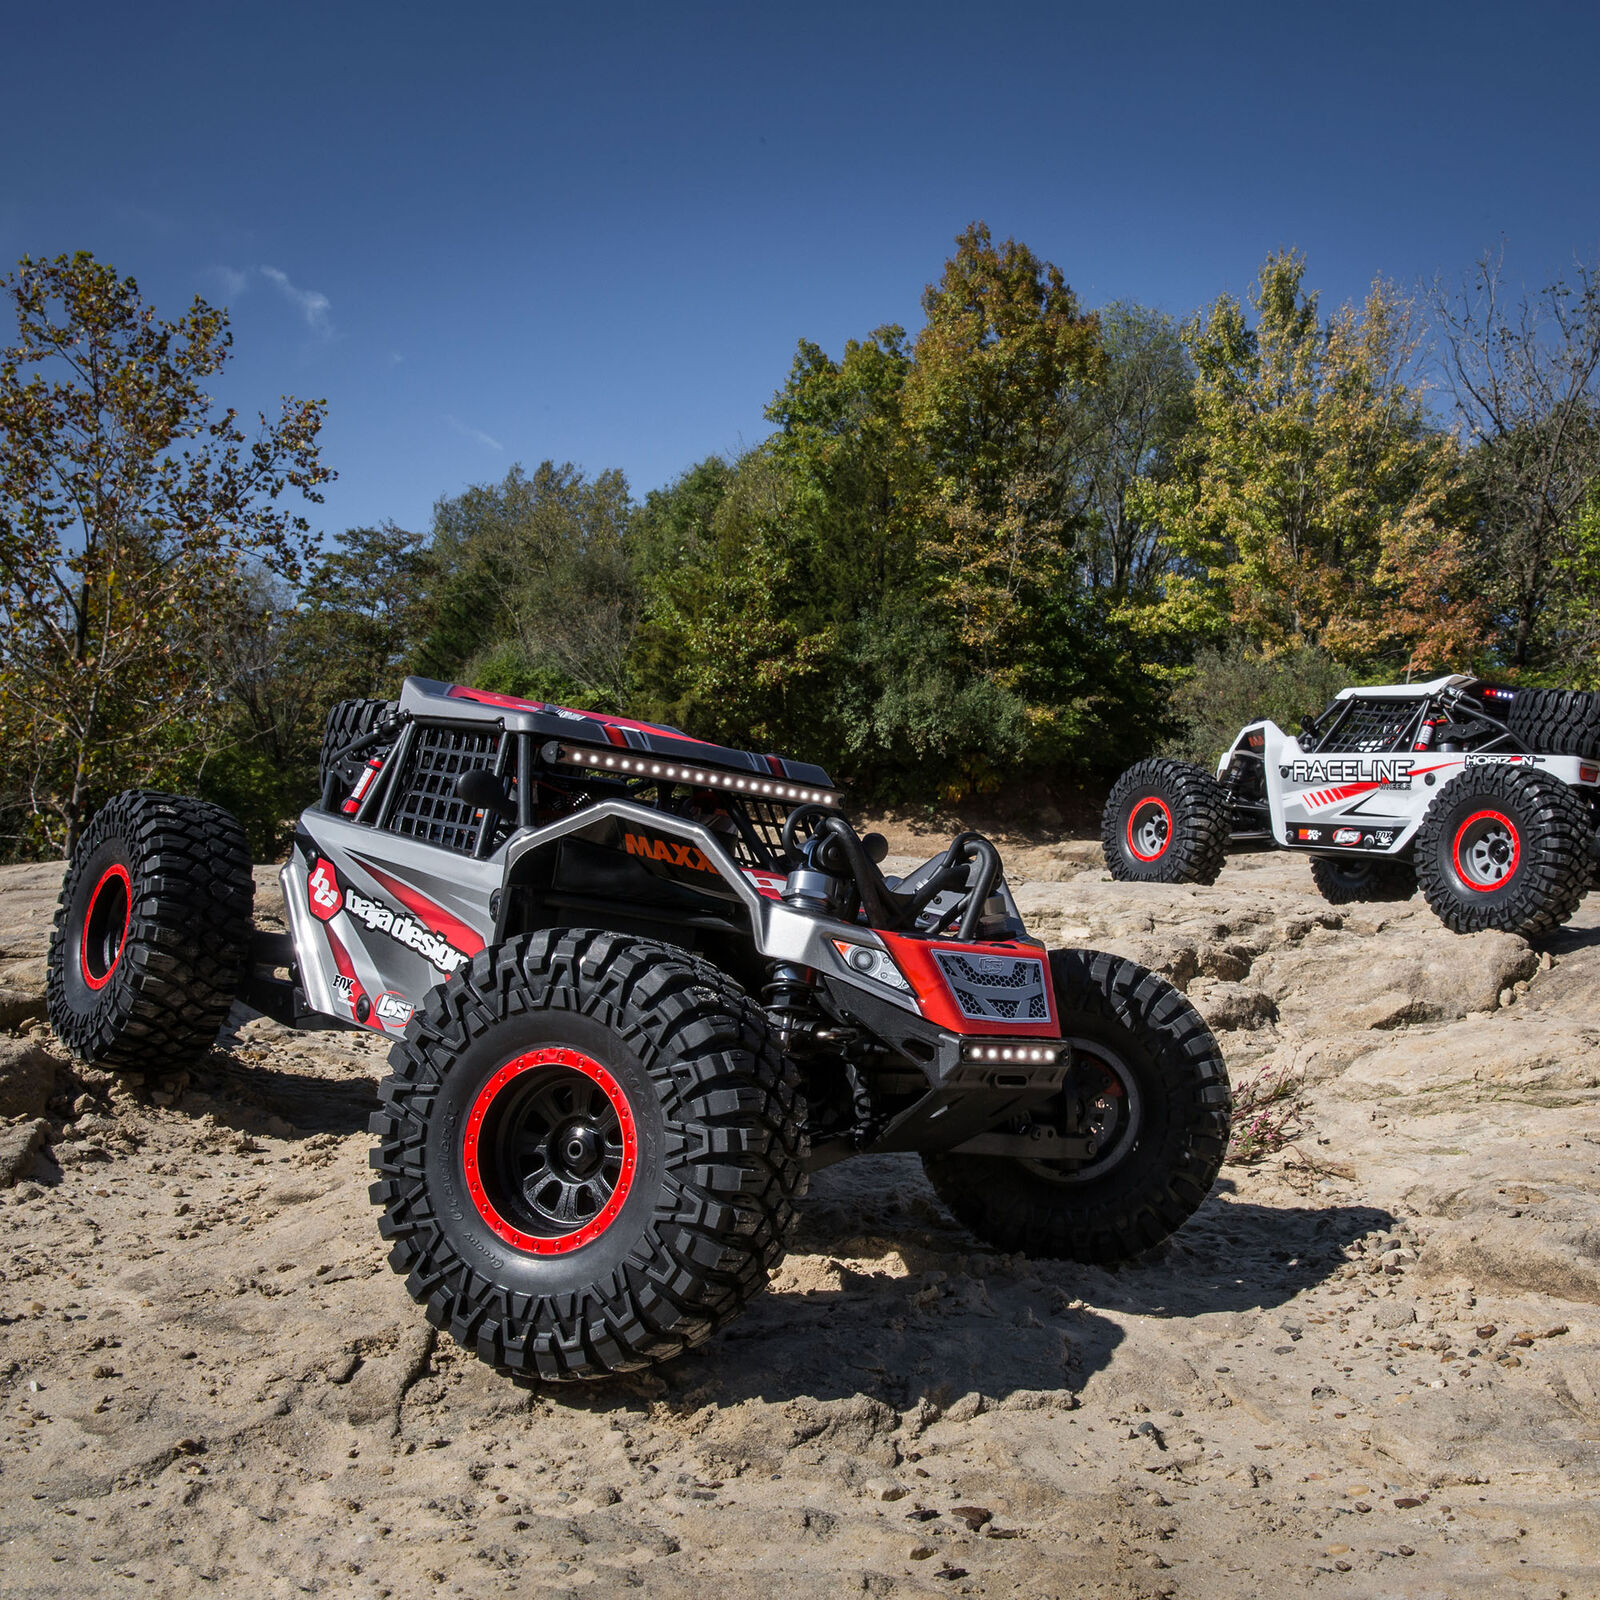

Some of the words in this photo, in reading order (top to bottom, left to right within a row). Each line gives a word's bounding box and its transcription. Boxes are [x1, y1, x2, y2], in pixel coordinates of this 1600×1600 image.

[1465, 755, 1535, 766] HORIZON
[1292, 760, 1413, 782] RACELINE
[1379, 783, 1411, 791] WHEELS
[332, 974, 354, 991] FOX
